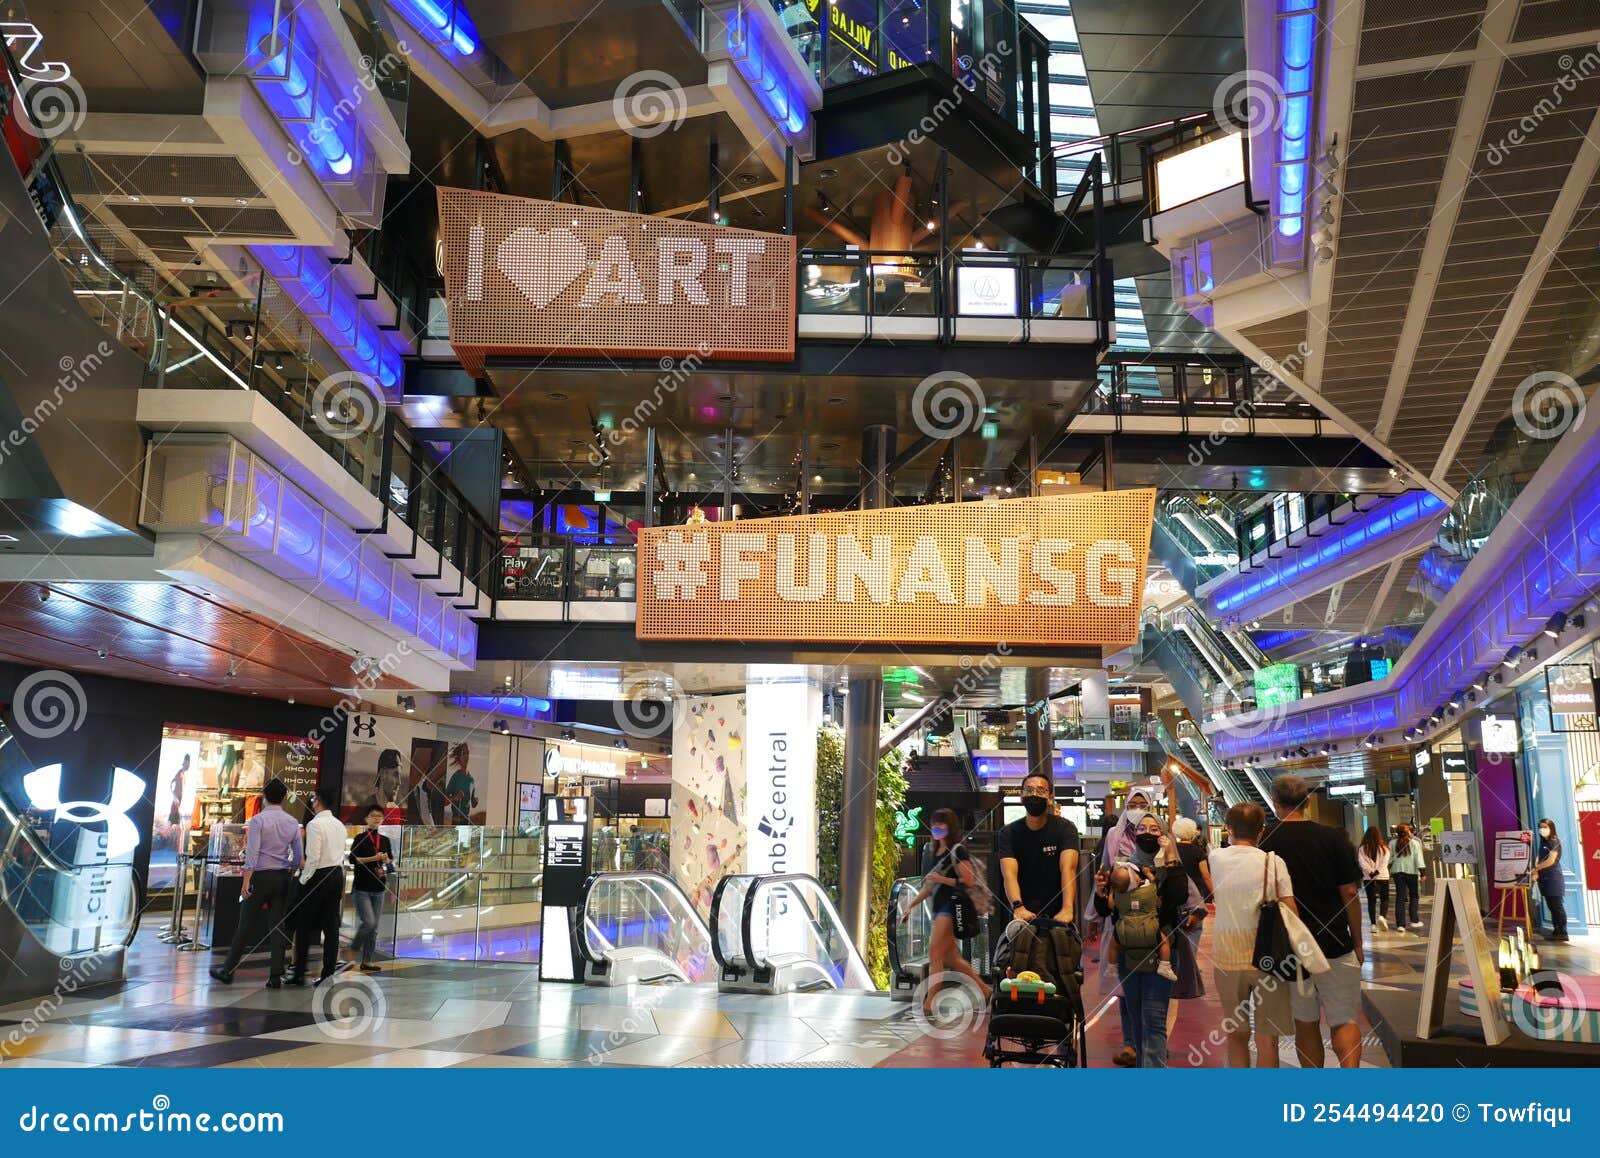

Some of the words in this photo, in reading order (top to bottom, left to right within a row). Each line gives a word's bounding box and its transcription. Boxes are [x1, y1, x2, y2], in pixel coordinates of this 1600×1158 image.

[467, 225, 484, 301] I
[575, 236, 766, 307] ART
[504, 558, 527, 570] Play
[653, 531, 1137, 608] #FUNANSG
[769, 733, 787, 821] central
